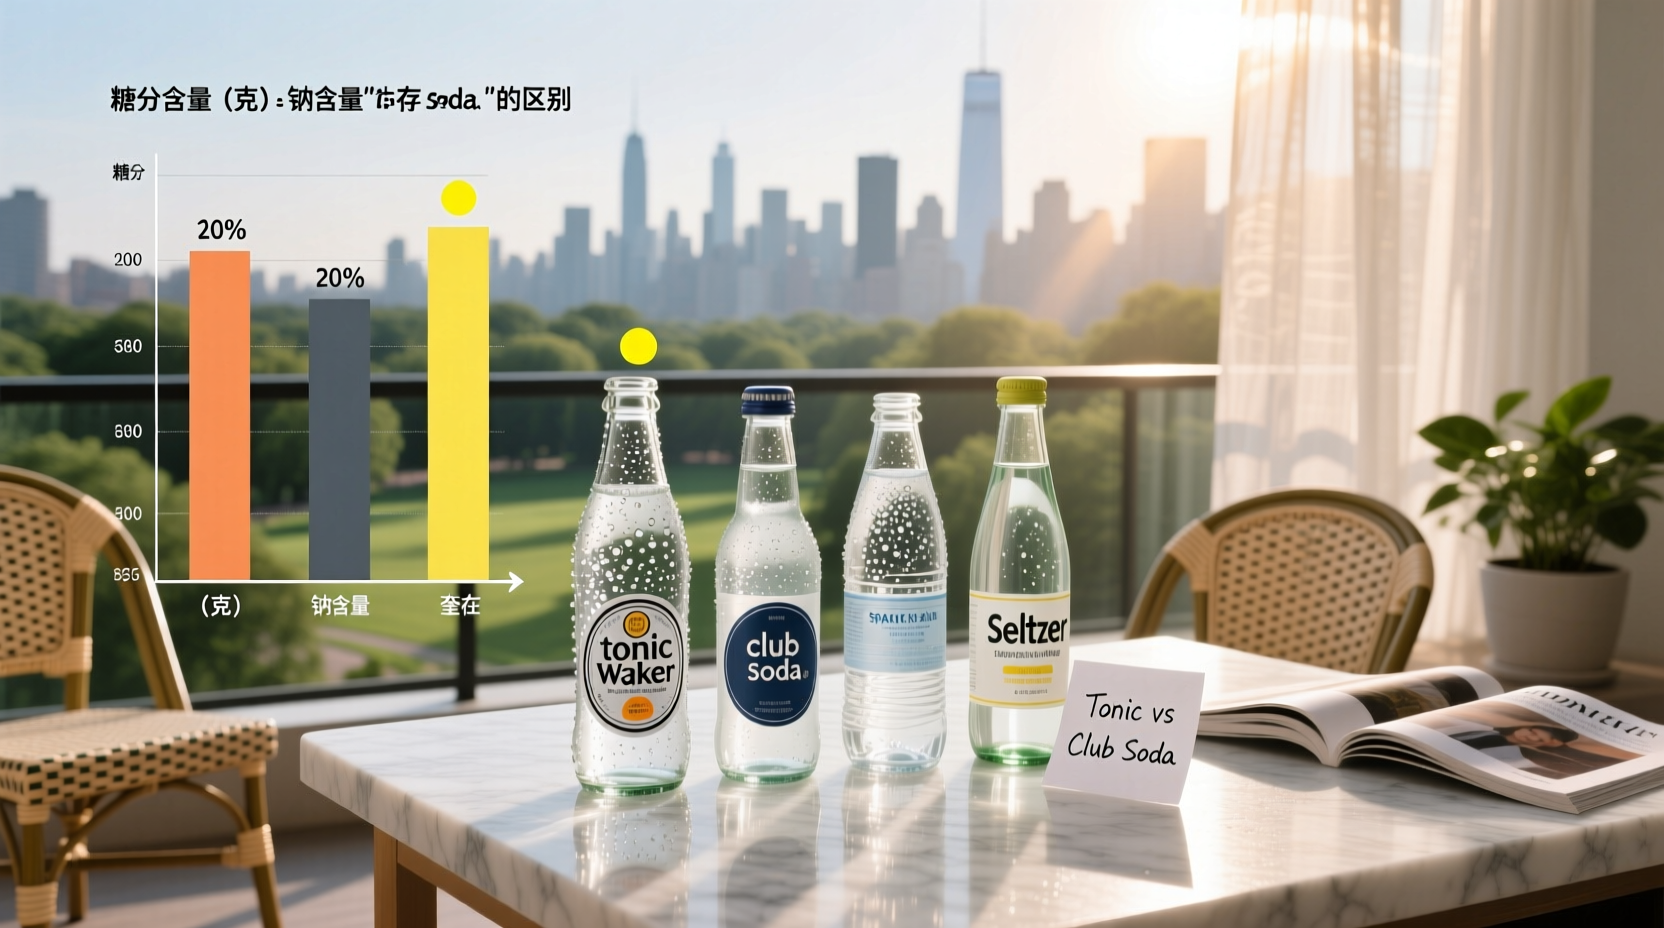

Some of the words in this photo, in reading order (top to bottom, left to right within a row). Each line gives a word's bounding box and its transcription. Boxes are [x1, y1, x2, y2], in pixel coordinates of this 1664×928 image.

[746, 631, 800, 657] club
[987, 612, 1068, 645] Seltzer
[600, 633, 673, 661] tonic
[1086, 693, 1142, 721] Tonic
[1152, 707, 1175, 724] vs
[1068, 732, 1115, 759] Club
[1121, 739, 1176, 765] Soda
